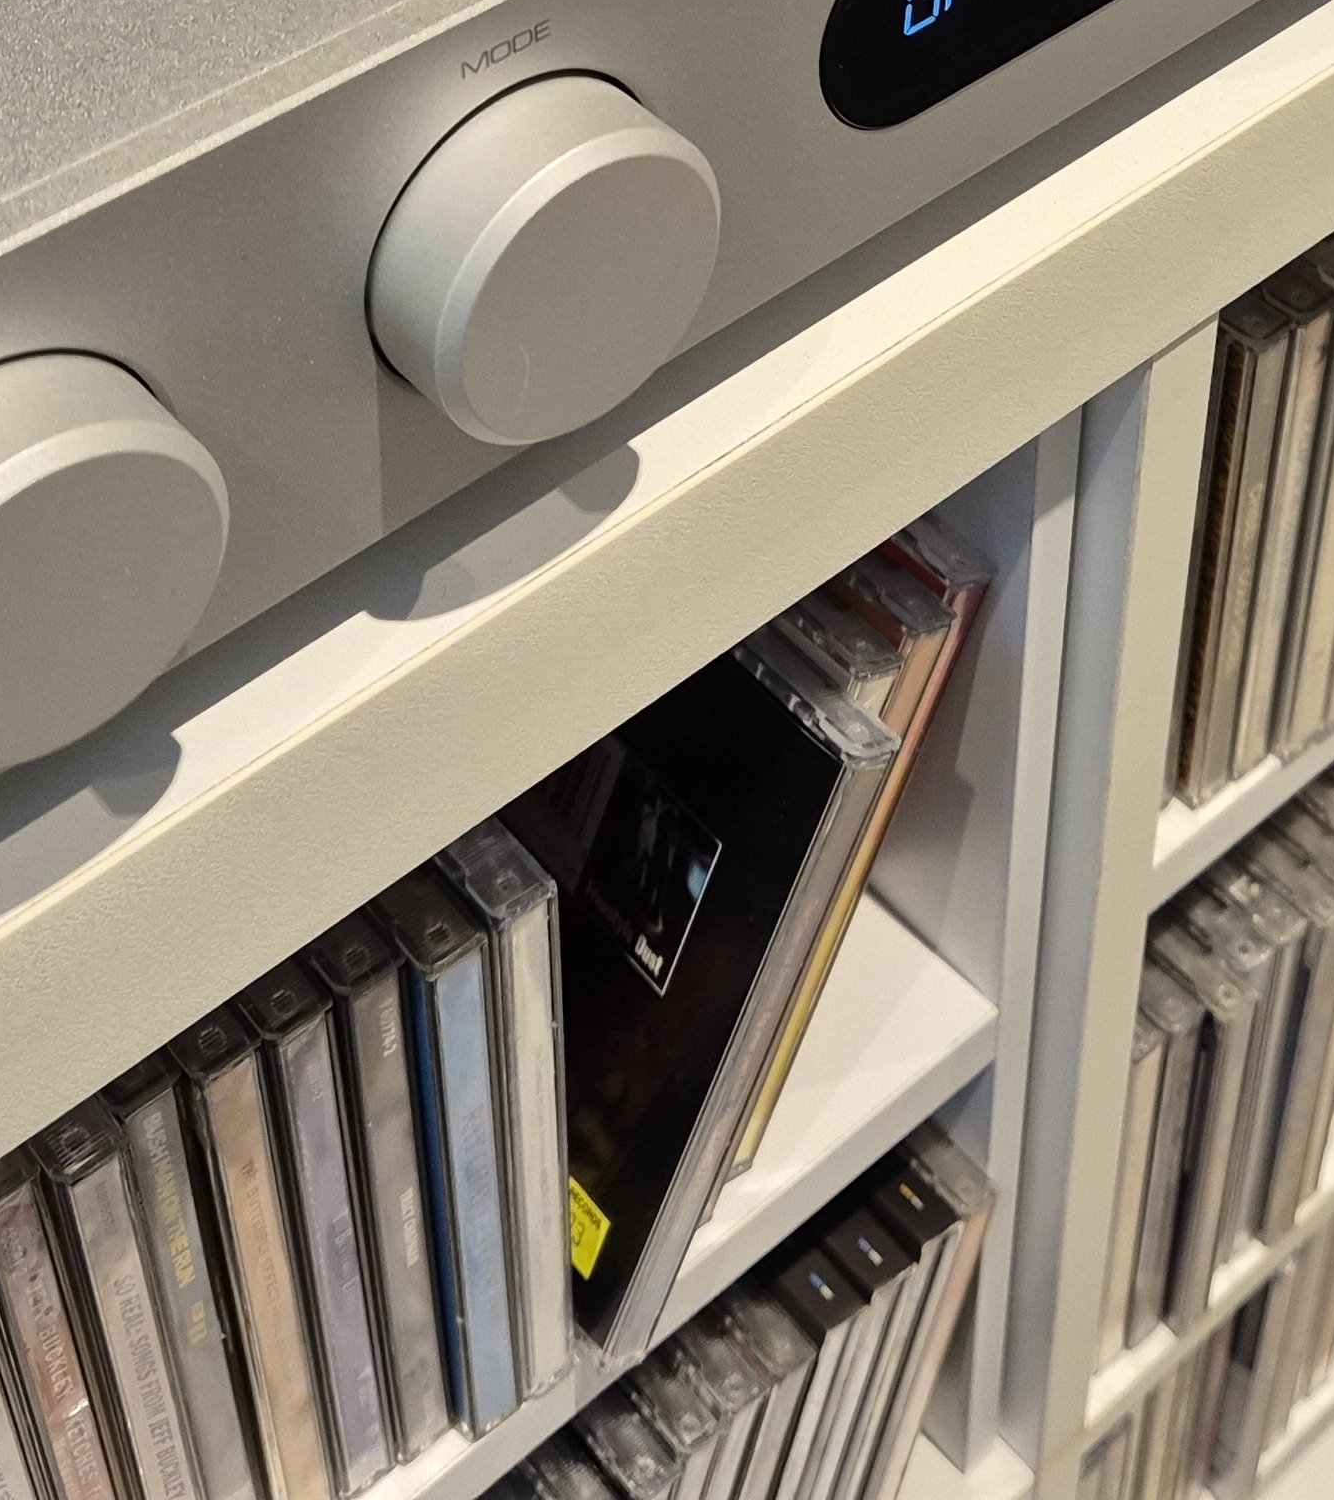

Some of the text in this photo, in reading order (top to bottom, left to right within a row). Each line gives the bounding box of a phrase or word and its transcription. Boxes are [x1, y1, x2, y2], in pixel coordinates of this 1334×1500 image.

[460, 18, 553, 79] MODE
[634, 933, 664, 979] Dust
[142, 1111, 168, 1163] BUSH
[113, 1274, 137, 1297] SO
[37, 1325, 75, 1401] BUCKLEY
[130, 1336, 157, 1381] SONGS
[140, 1378, 166, 1420] FROM
[148, 1417, 174, 1446] JEFF
[155, 1443, 187, 1498] BUCKLEY
